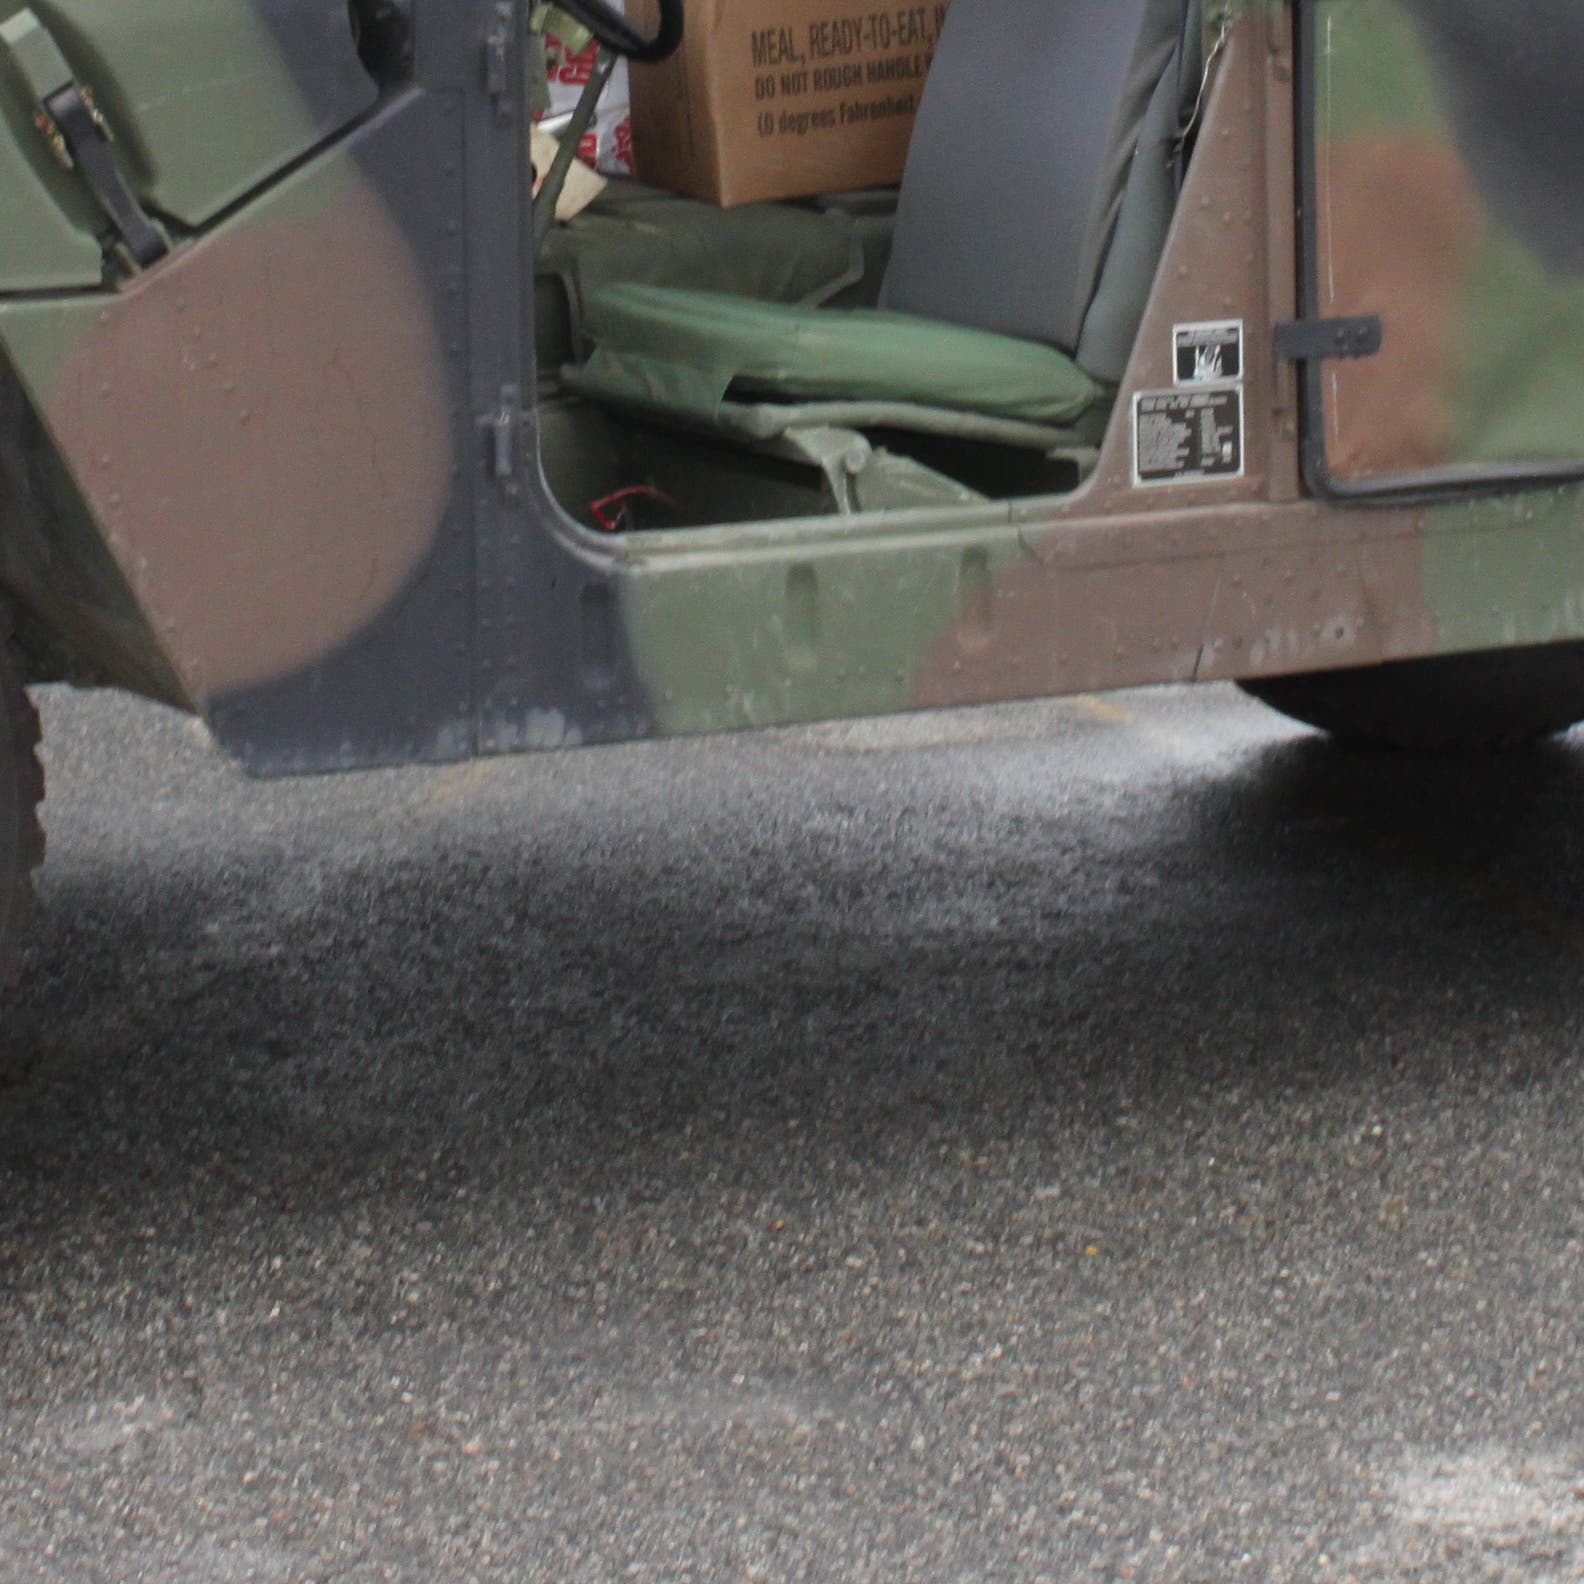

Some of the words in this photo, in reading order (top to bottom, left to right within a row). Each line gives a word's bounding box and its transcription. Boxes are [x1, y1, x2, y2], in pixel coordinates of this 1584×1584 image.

[751, 26, 806, 68] MEAL,
[809, 7, 933, 60] READY-TO-EAT,
[755, 74, 776, 101] DO
[780, 71, 808, 97] NOT
[813, 63, 863, 92] ROUGH
[867, 54, 921, 84] HANDLE
[778, 108, 837, 136] degrees
